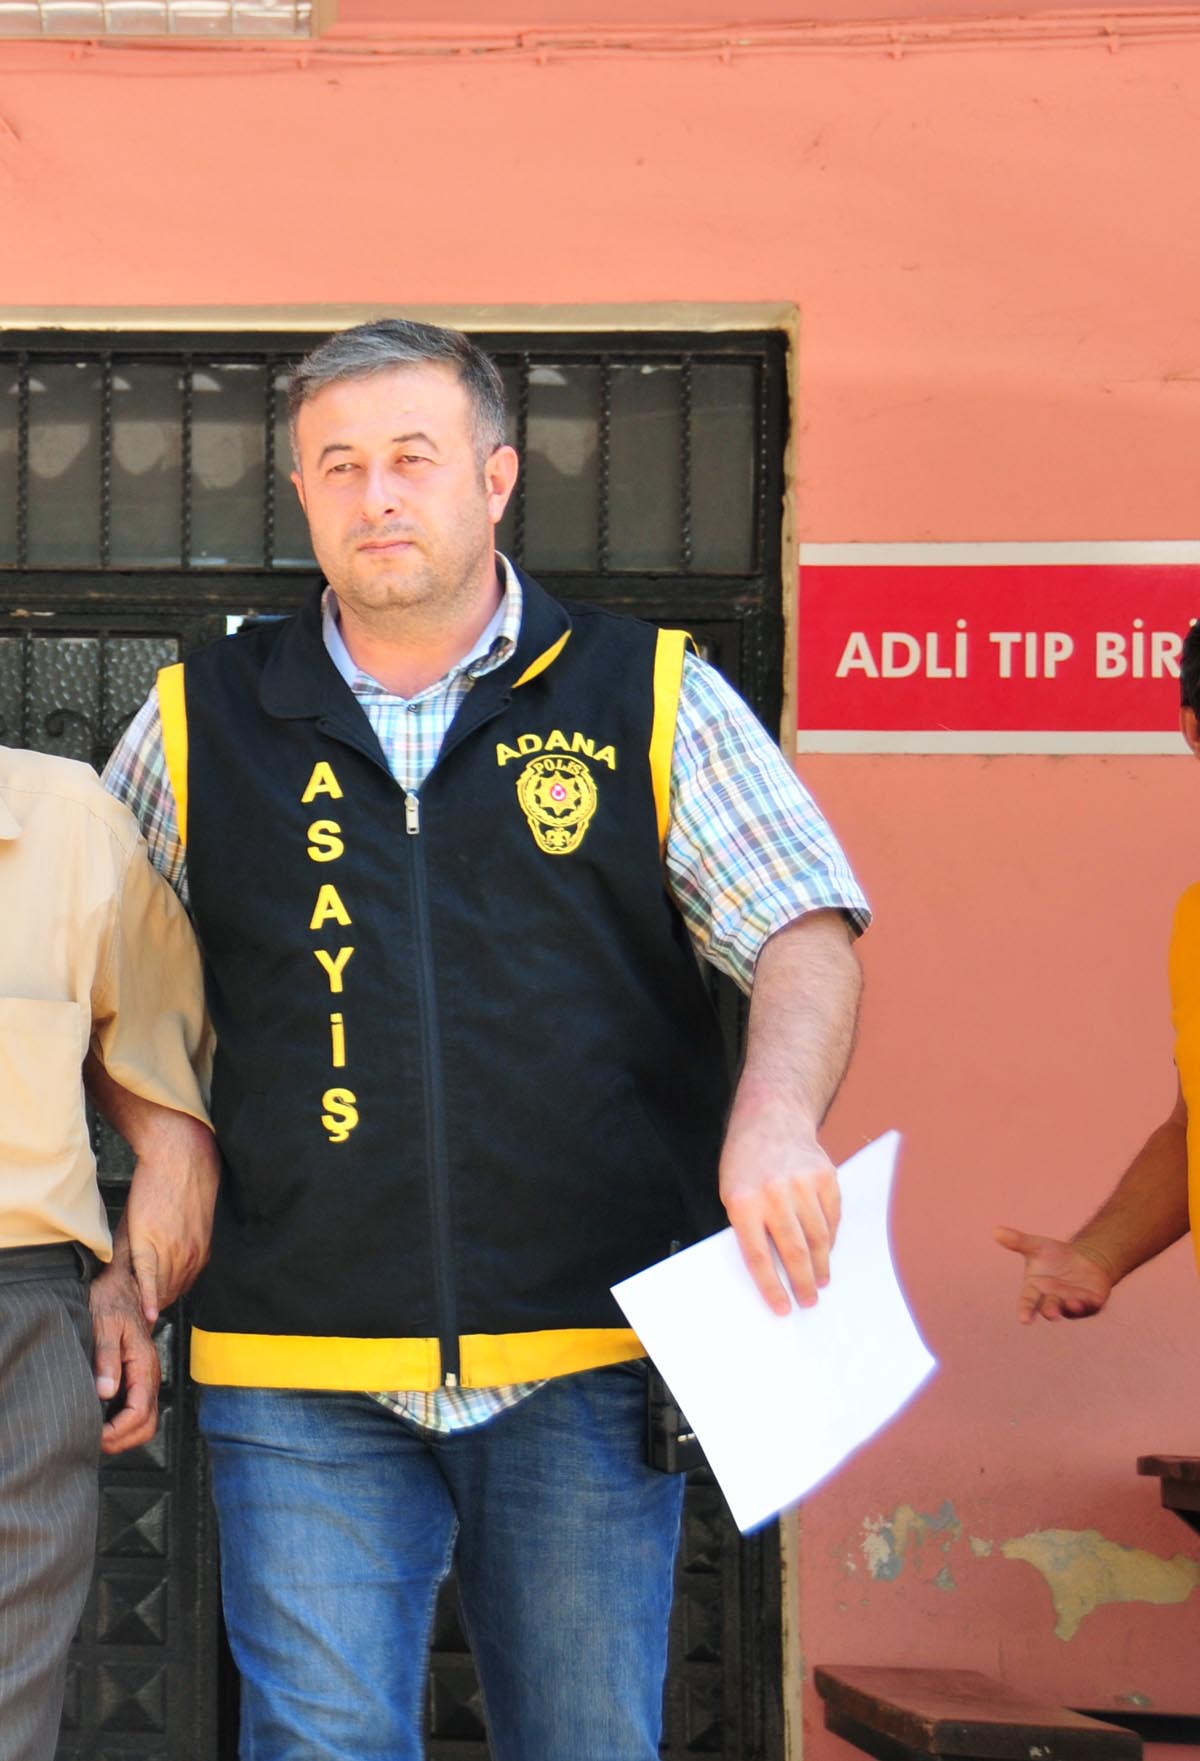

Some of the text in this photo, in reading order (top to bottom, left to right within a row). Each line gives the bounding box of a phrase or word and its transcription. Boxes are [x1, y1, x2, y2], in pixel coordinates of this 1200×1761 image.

[835, 618, 1197, 678] ADLİ TIP BİR
[496, 729, 616, 770] ADANA
[301, 761, 359, 1143] ASAYİŞ
